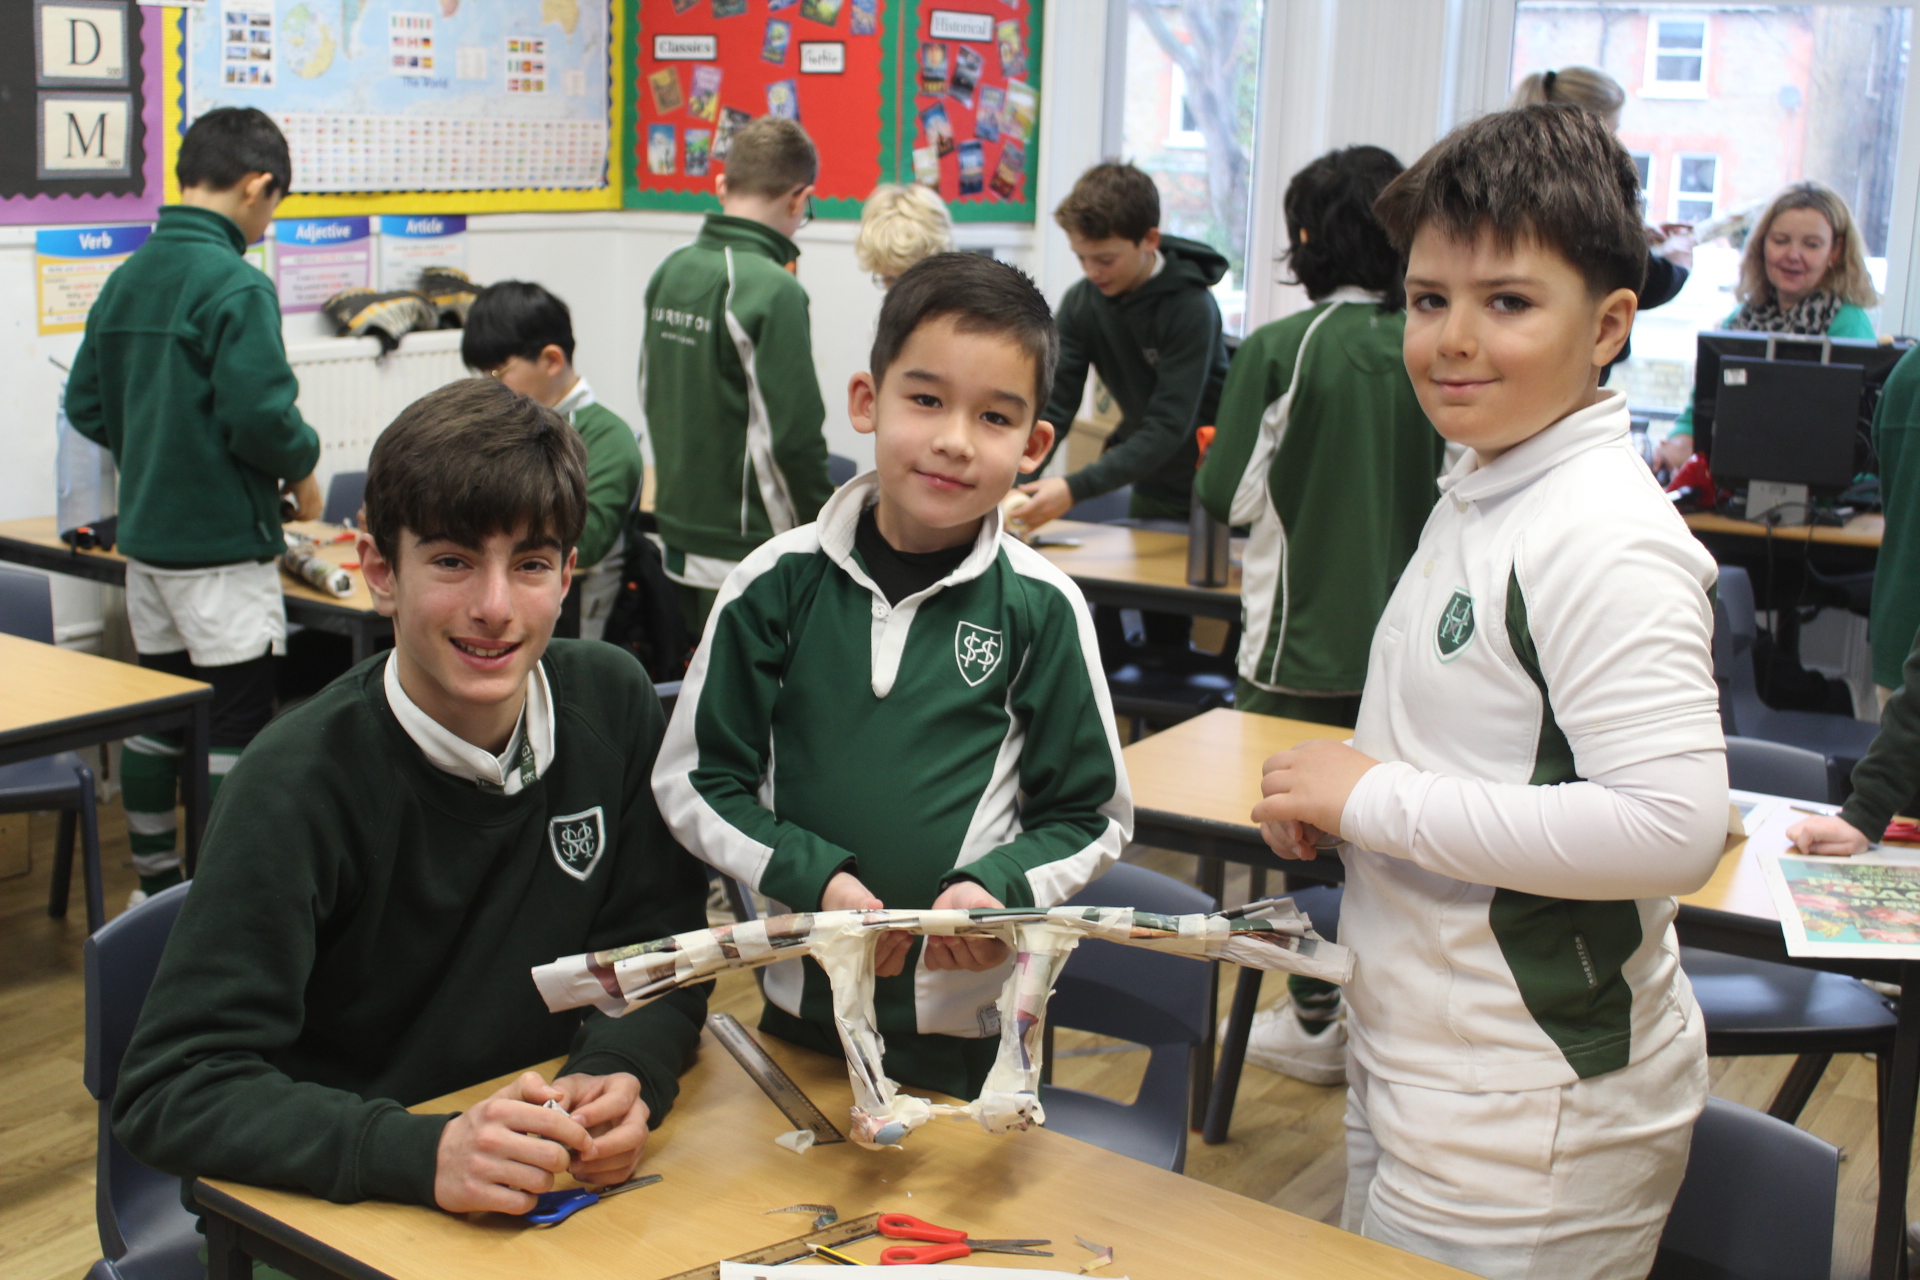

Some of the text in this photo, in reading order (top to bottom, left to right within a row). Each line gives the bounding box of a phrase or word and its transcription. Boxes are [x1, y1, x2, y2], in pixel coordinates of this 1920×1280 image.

[934, 16, 988, 36] Historical
[67, 18, 102, 66] D
[658, 39, 712, 54] Classics
[64, 111, 109, 159] M
[295, 222, 351, 243] Adjective
[405, 218, 445, 235] Article
[78, 230, 113, 250] Verb
